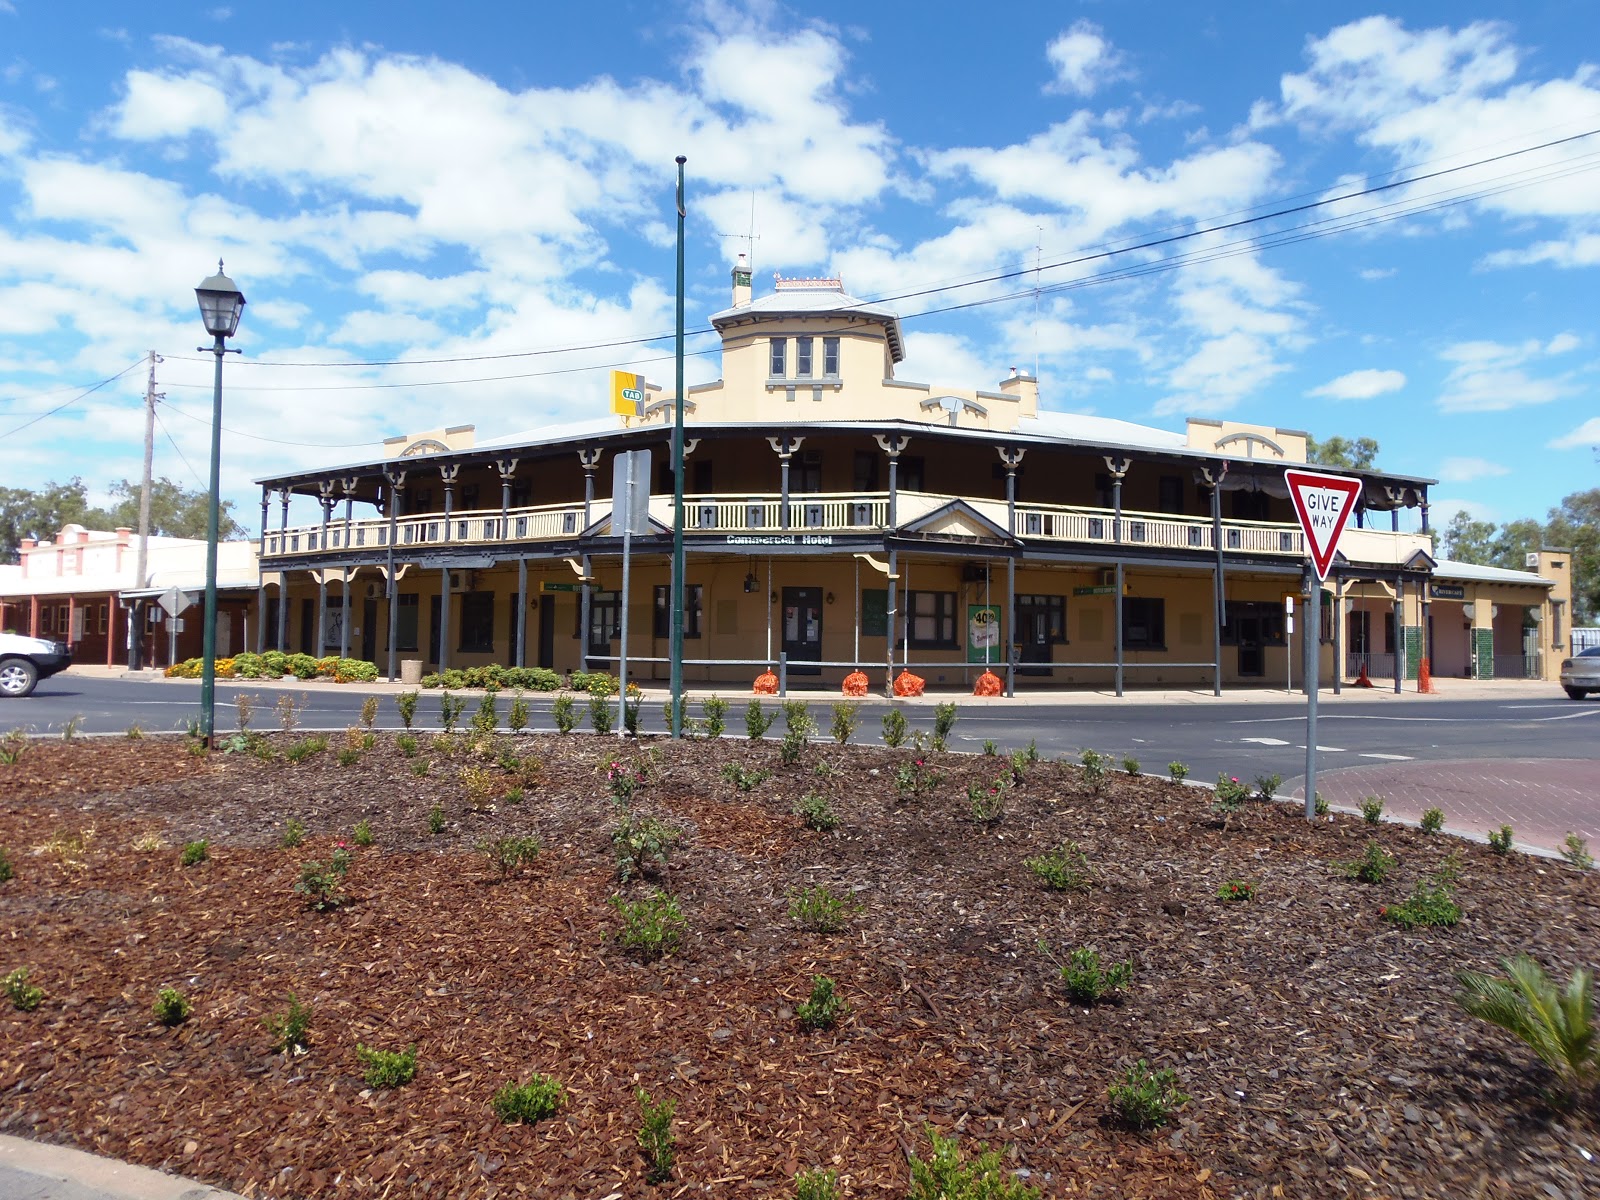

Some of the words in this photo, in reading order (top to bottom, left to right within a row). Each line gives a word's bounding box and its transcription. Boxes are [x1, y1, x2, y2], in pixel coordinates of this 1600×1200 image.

[624, 390, 640, 399] TAB
[1308, 493, 1339, 512] GIVE
[1312, 514, 1334, 529] WAY
[726, 535, 796, 545] Commercial
[802, 535, 833, 545] Hotel
